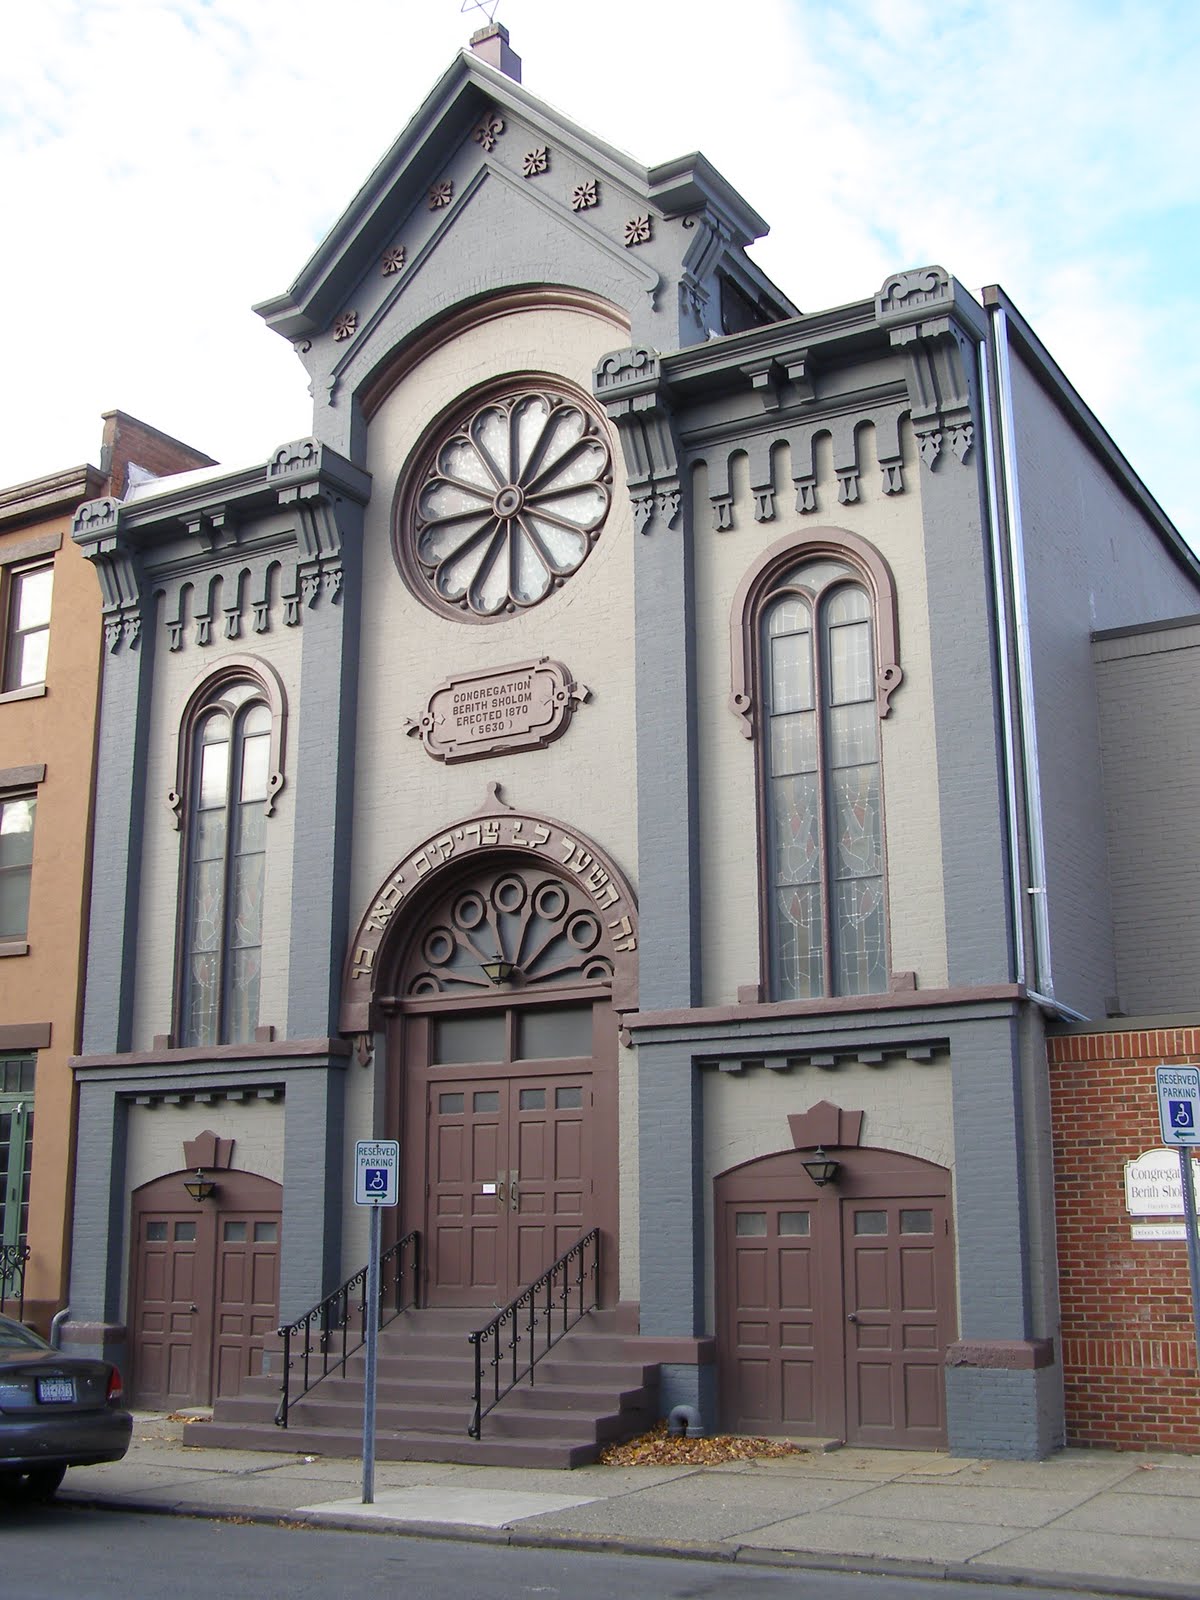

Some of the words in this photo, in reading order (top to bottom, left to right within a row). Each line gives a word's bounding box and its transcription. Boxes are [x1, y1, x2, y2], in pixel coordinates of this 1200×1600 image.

[453, 680, 531, 704] CONGREGATION
[453, 700, 488, 716] BERITH
[491, 692, 532, 708] SHOLOM
[456, 709, 502, 727] ERECTED
[505, 704, 529, 718] 1870
[1159, 1074, 1198, 1085] RESERVED
[1162, 1087, 1197, 1098] PARKING
[358, 1147, 396, 1156] RESERVED
[360, 1158, 394, 1167] PARKING
[1131, 1167, 1195, 1181] Congregat
[1131, 1185, 1159, 1198] Berith
[1162, 1184, 1197, 1197] Shol
